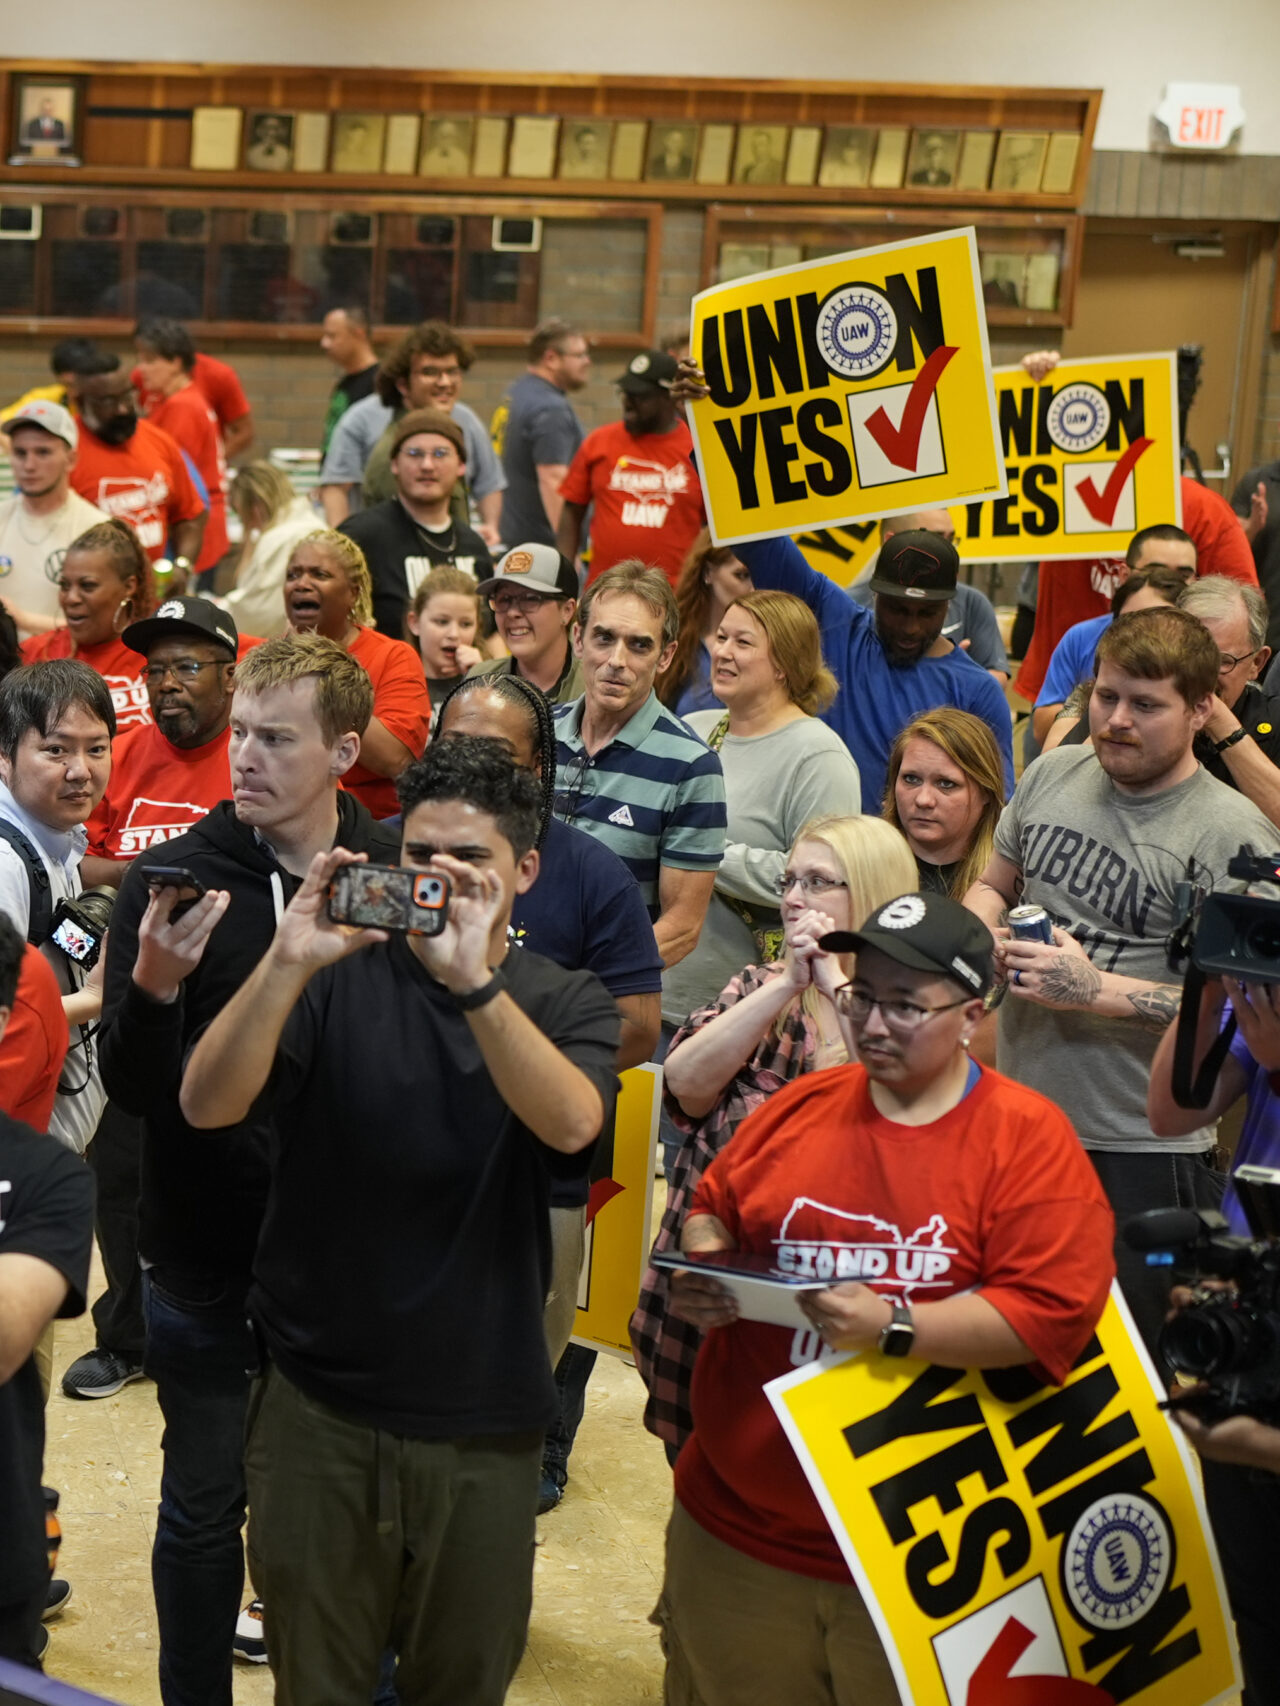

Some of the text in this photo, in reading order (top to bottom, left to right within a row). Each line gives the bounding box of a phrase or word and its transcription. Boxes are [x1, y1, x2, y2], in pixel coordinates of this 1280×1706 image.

[1178, 107, 1226, 144] EXIT
[701, 266, 945, 408] UNION
[841, 322, 869, 342] UAW
[995, 378, 1146, 459] NION
[1067, 412, 1088, 425] UAW
[714, 398, 852, 510] YES
[621, 501, 669, 528] UAW
[119, 828, 188, 851] STA
[895, 1250, 951, 1282] UP
[842, 1363, 1032, 1619] YES
[1103, 1537, 1132, 1584] UAW
